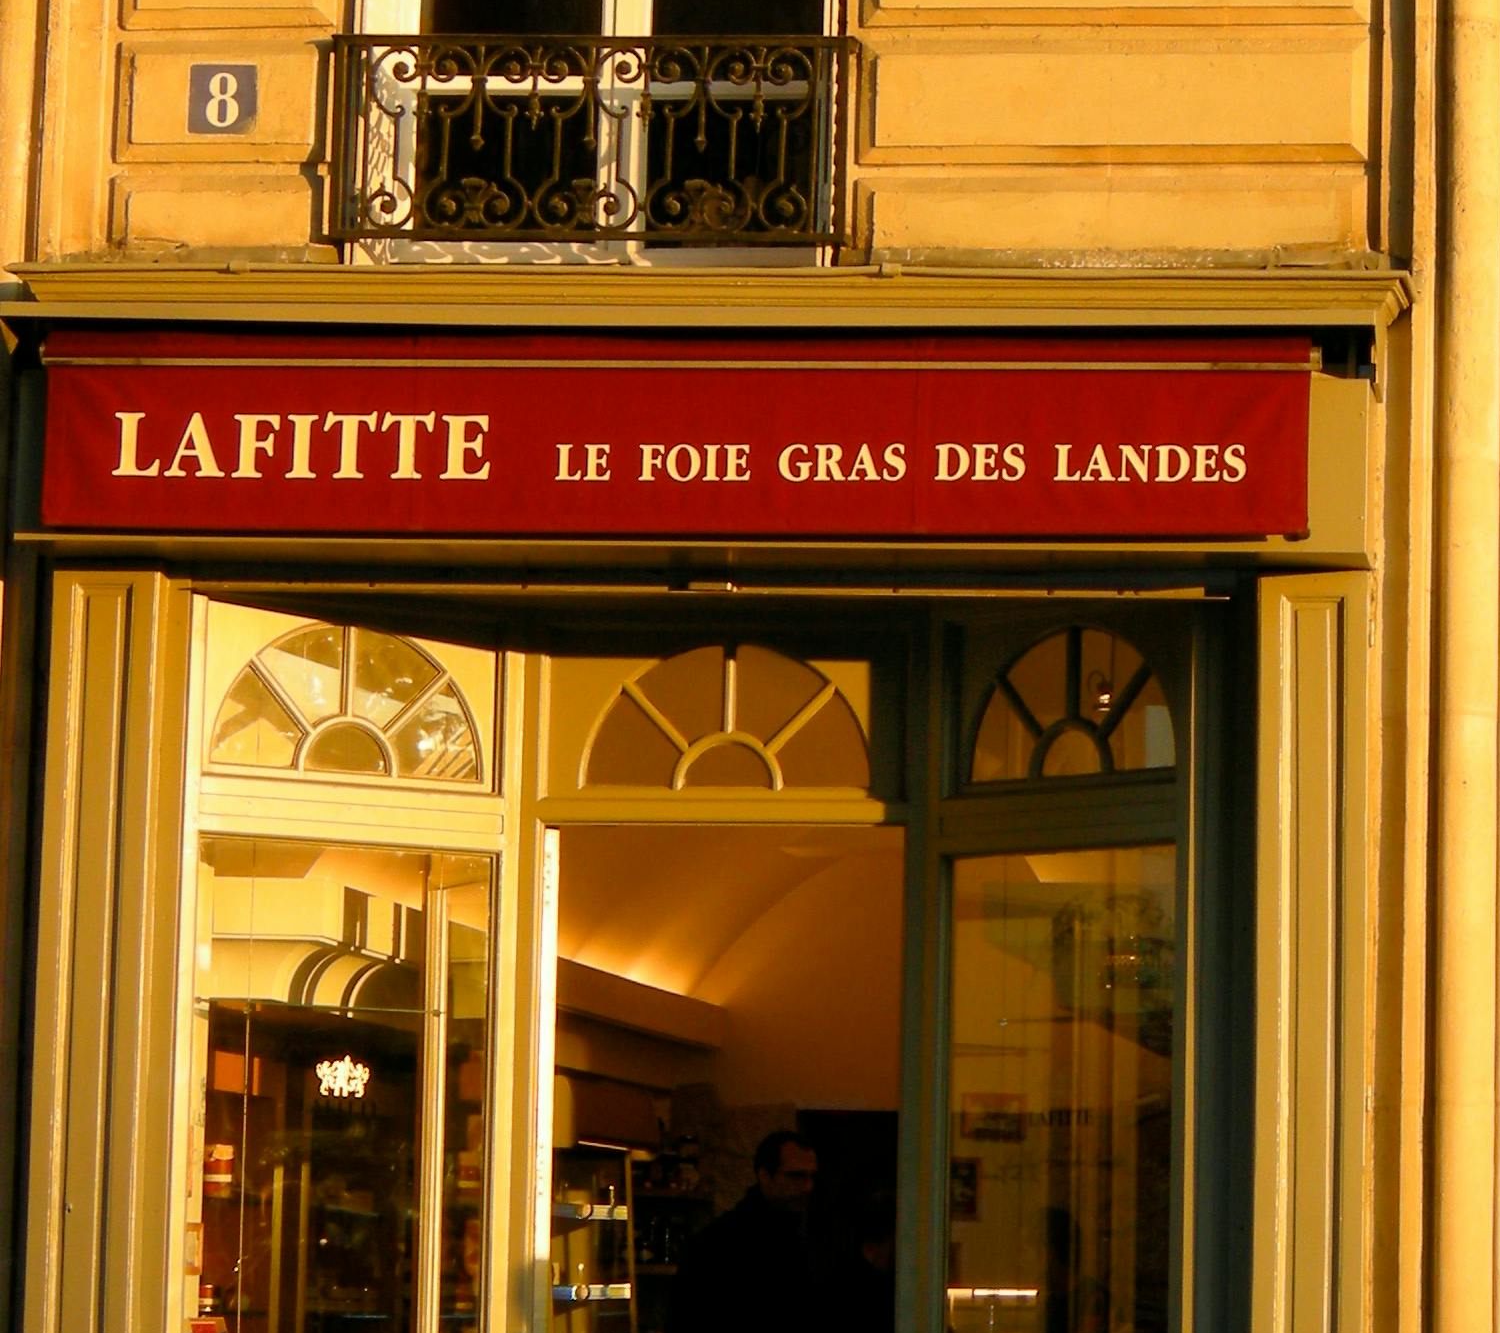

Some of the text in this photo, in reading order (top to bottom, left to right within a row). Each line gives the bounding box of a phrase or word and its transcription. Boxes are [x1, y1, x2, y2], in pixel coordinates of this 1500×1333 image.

[205, 72, 239, 127] 8
[111, 410, 1248, 483] LAFITTE LE FOIE GRAS DES LANDES
